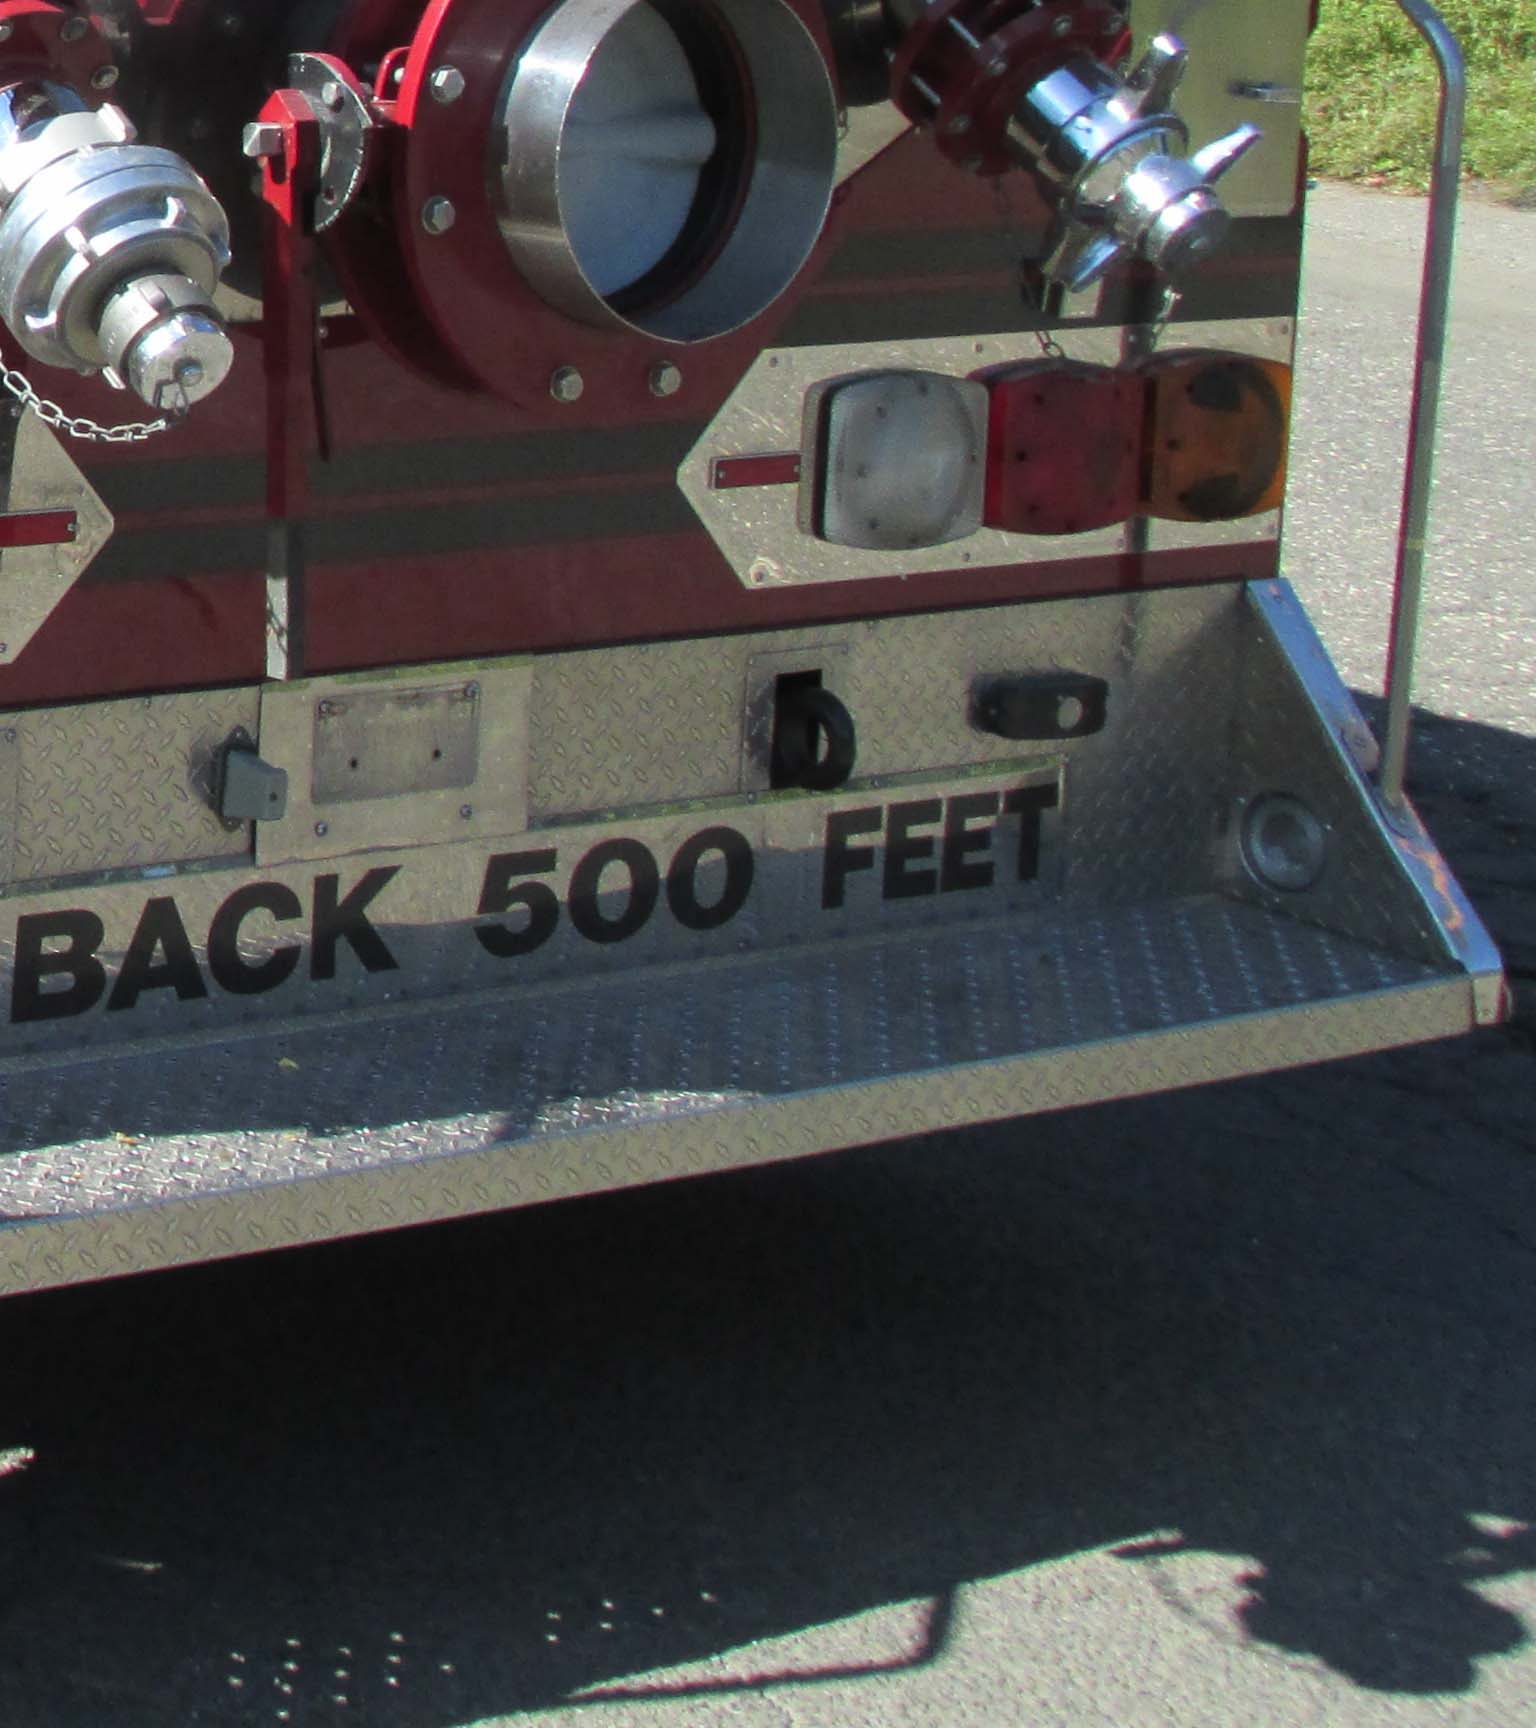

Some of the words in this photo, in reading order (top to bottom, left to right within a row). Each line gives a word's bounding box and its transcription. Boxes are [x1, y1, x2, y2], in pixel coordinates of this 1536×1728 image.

[9, 864, 401, 1024] BACK
[473, 825, 755, 958] 500
[821, 782, 1061, 910] FEET
